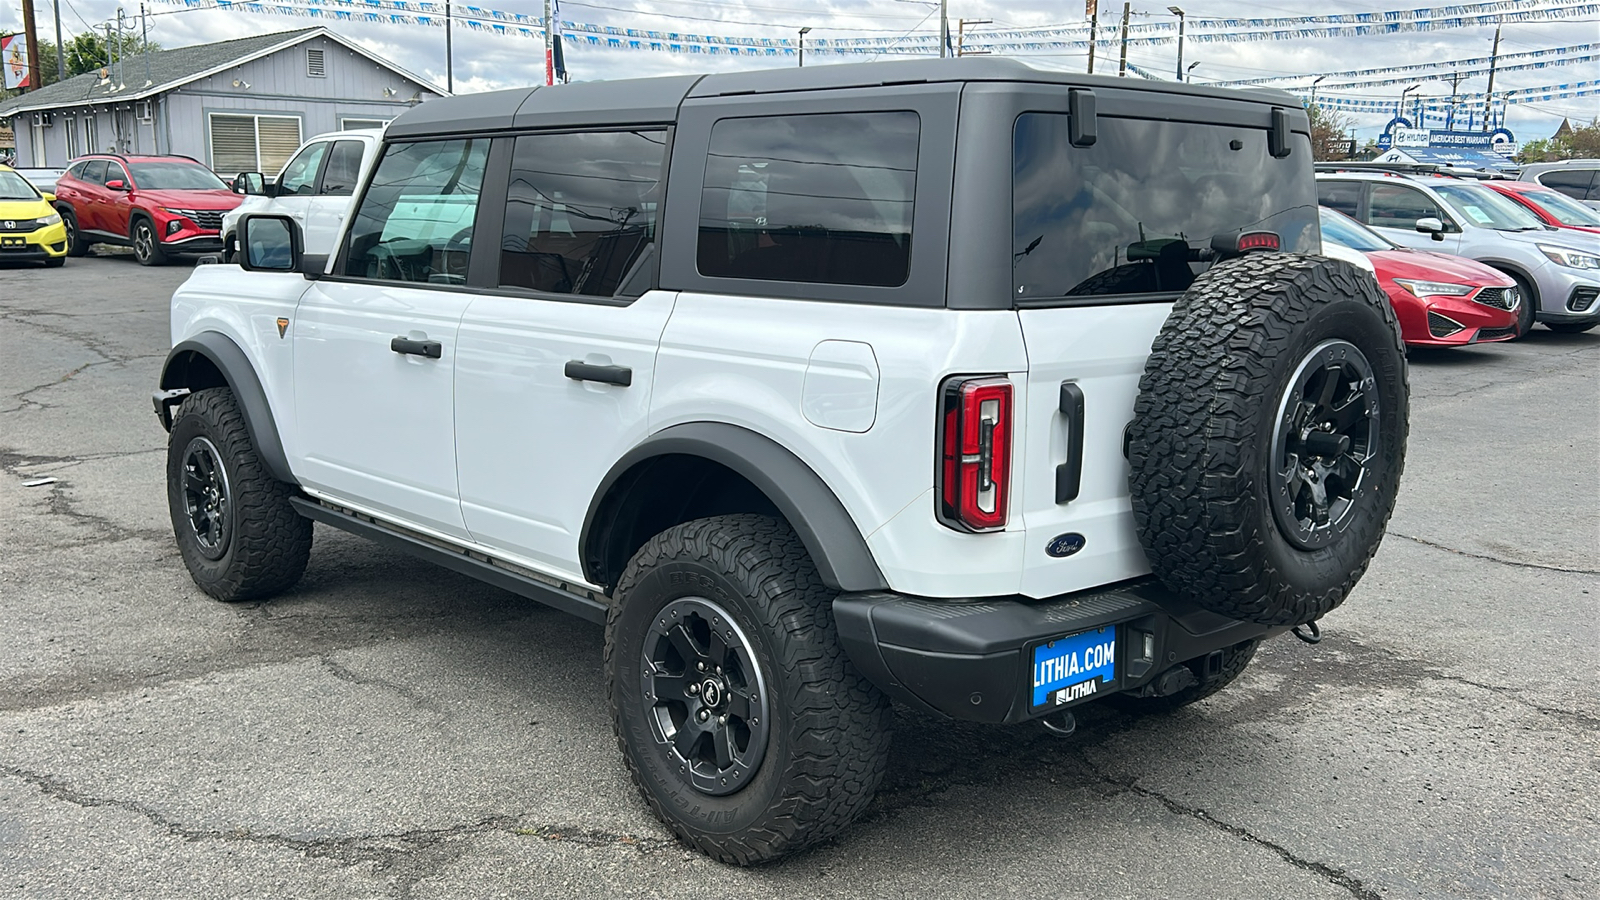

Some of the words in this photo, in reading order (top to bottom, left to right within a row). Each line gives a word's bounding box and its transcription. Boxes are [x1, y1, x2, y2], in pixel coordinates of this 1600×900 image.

[1430, 135, 1454, 143] AMERICA'S
[1455, 135, 1466, 144] BEST
[1466, 136, 1491, 144] WARRANTY
[1056, 540, 1079, 553] Ford
[1034, 641, 1115, 688] LITHIA.COM
[1065, 679, 1097, 702] LITHIA
